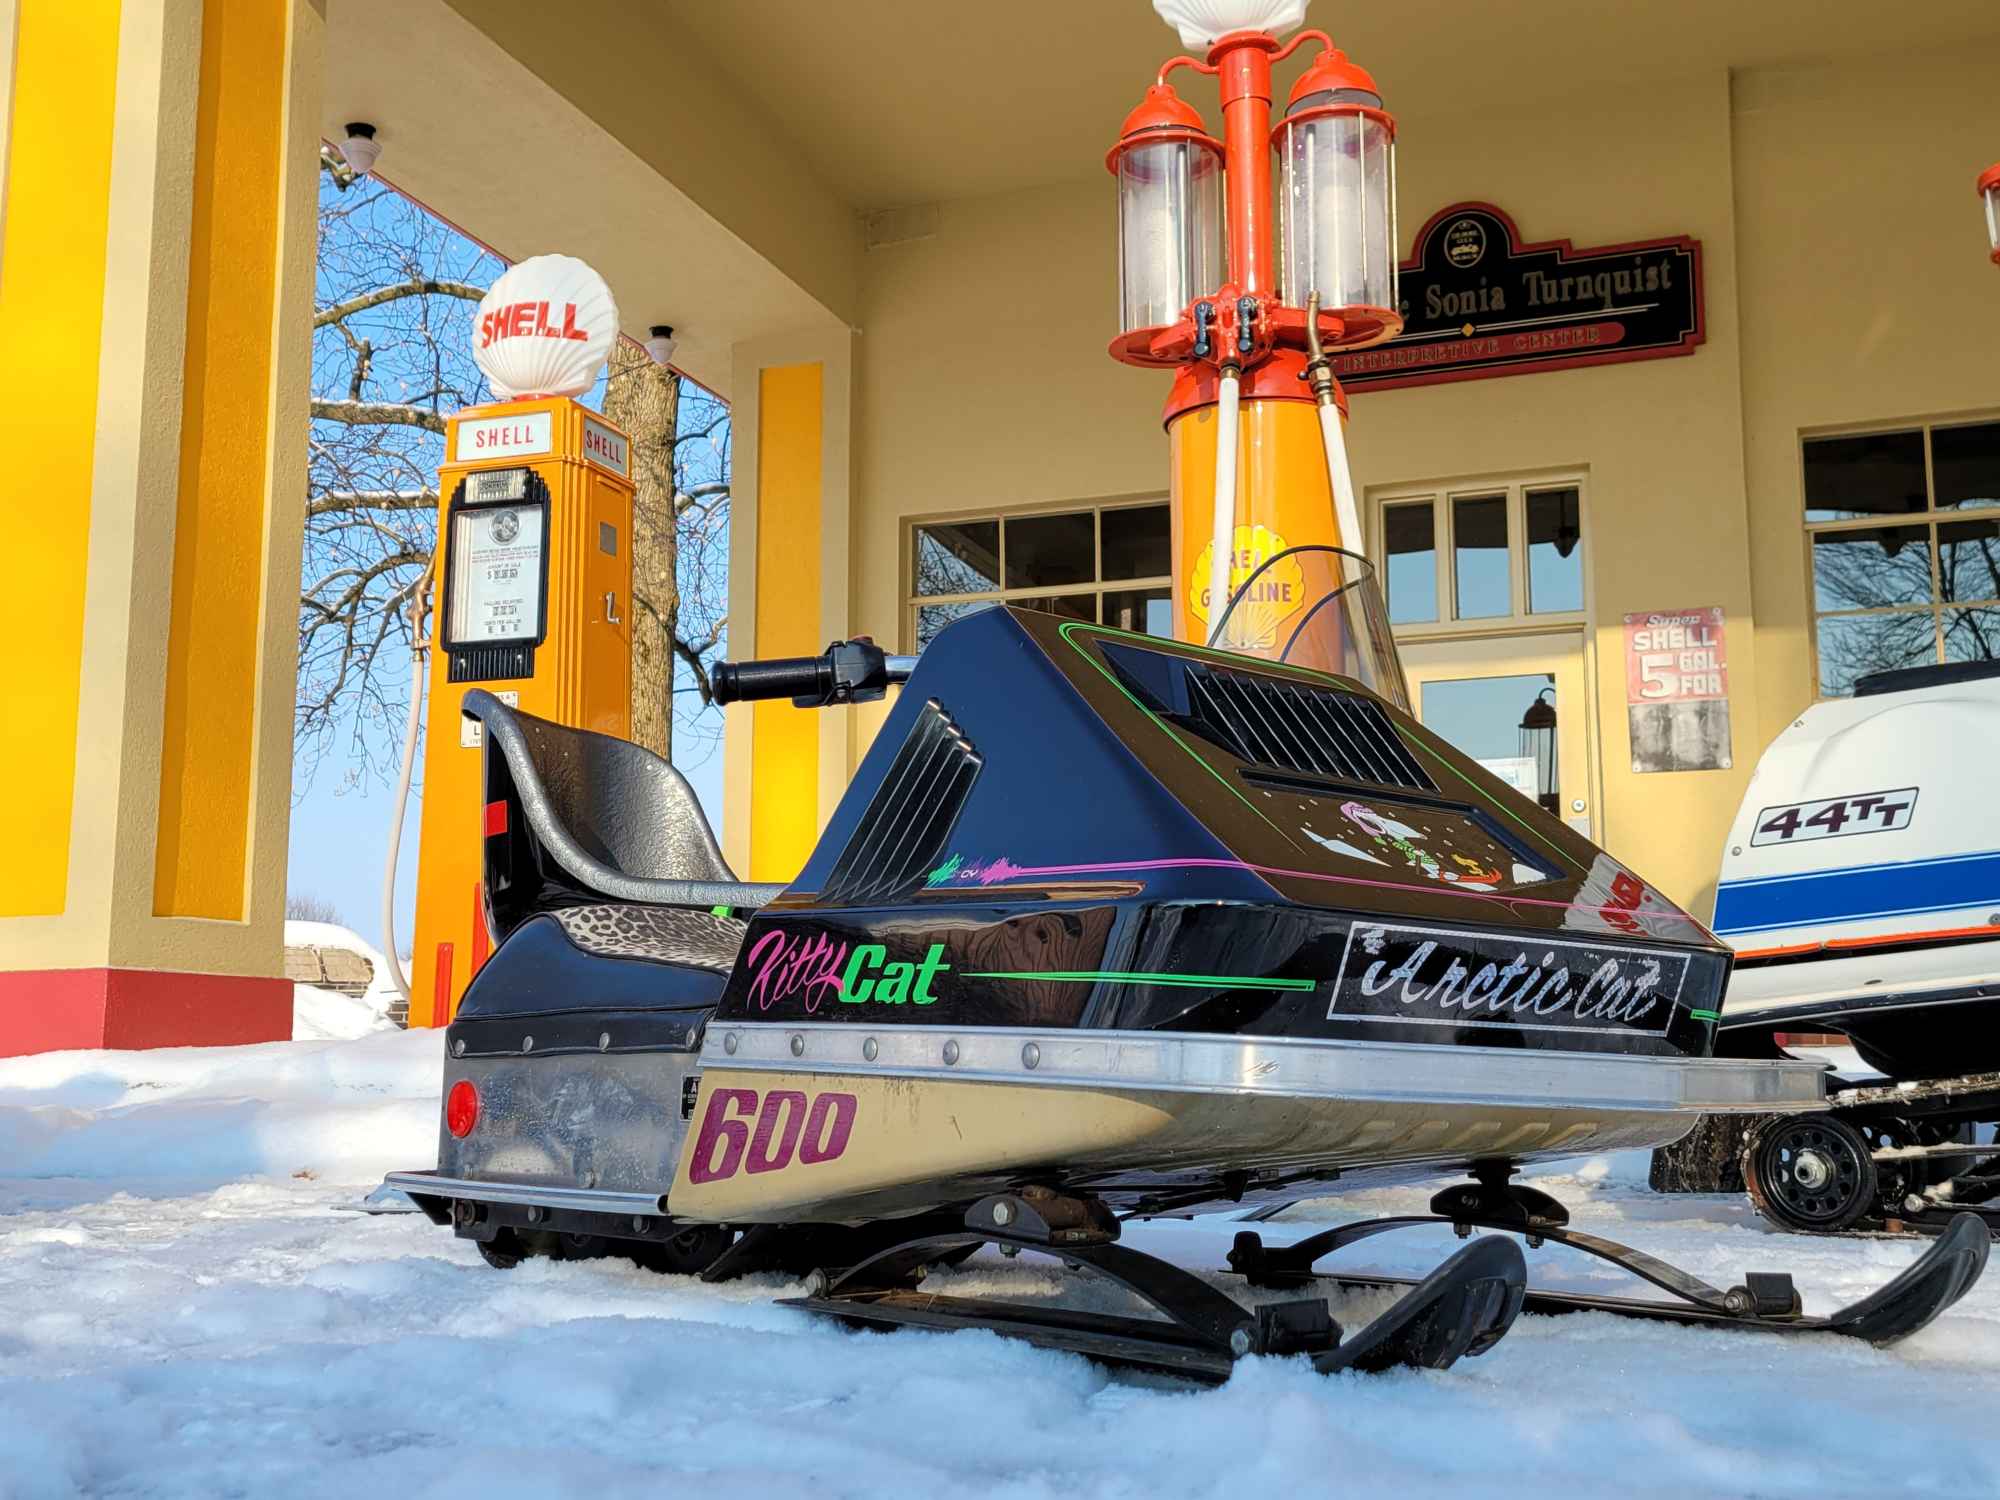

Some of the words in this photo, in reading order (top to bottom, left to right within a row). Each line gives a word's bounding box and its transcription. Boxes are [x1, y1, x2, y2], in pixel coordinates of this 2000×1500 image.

[1425, 275, 1506, 319] Sonia
[1522, 255, 1673, 309] Turnquist
[481, 301, 588, 349] SHELL
[1343, 340, 1499, 372] INTERPRETIVE
[1512, 327, 1600, 351] CENTER
[475, 424, 534, 449] SHELL
[585, 429, 622, 465] SHELL
[1201, 582, 1292, 608] GSLINE
[1633, 625, 1717, 652] SHELL
[1641, 653, 1679, 698] 5
[1681, 672, 1723, 695] FOR
[1760, 796, 1909, 839] 44TT
[747, 929, 848, 1013] Kitty
[838, 943, 951, 1005] Cat
[1361, 940, 1574, 1014] Arctic
[1574, 957, 1661, 1022] Cat
[688, 1087, 858, 1185] 600
